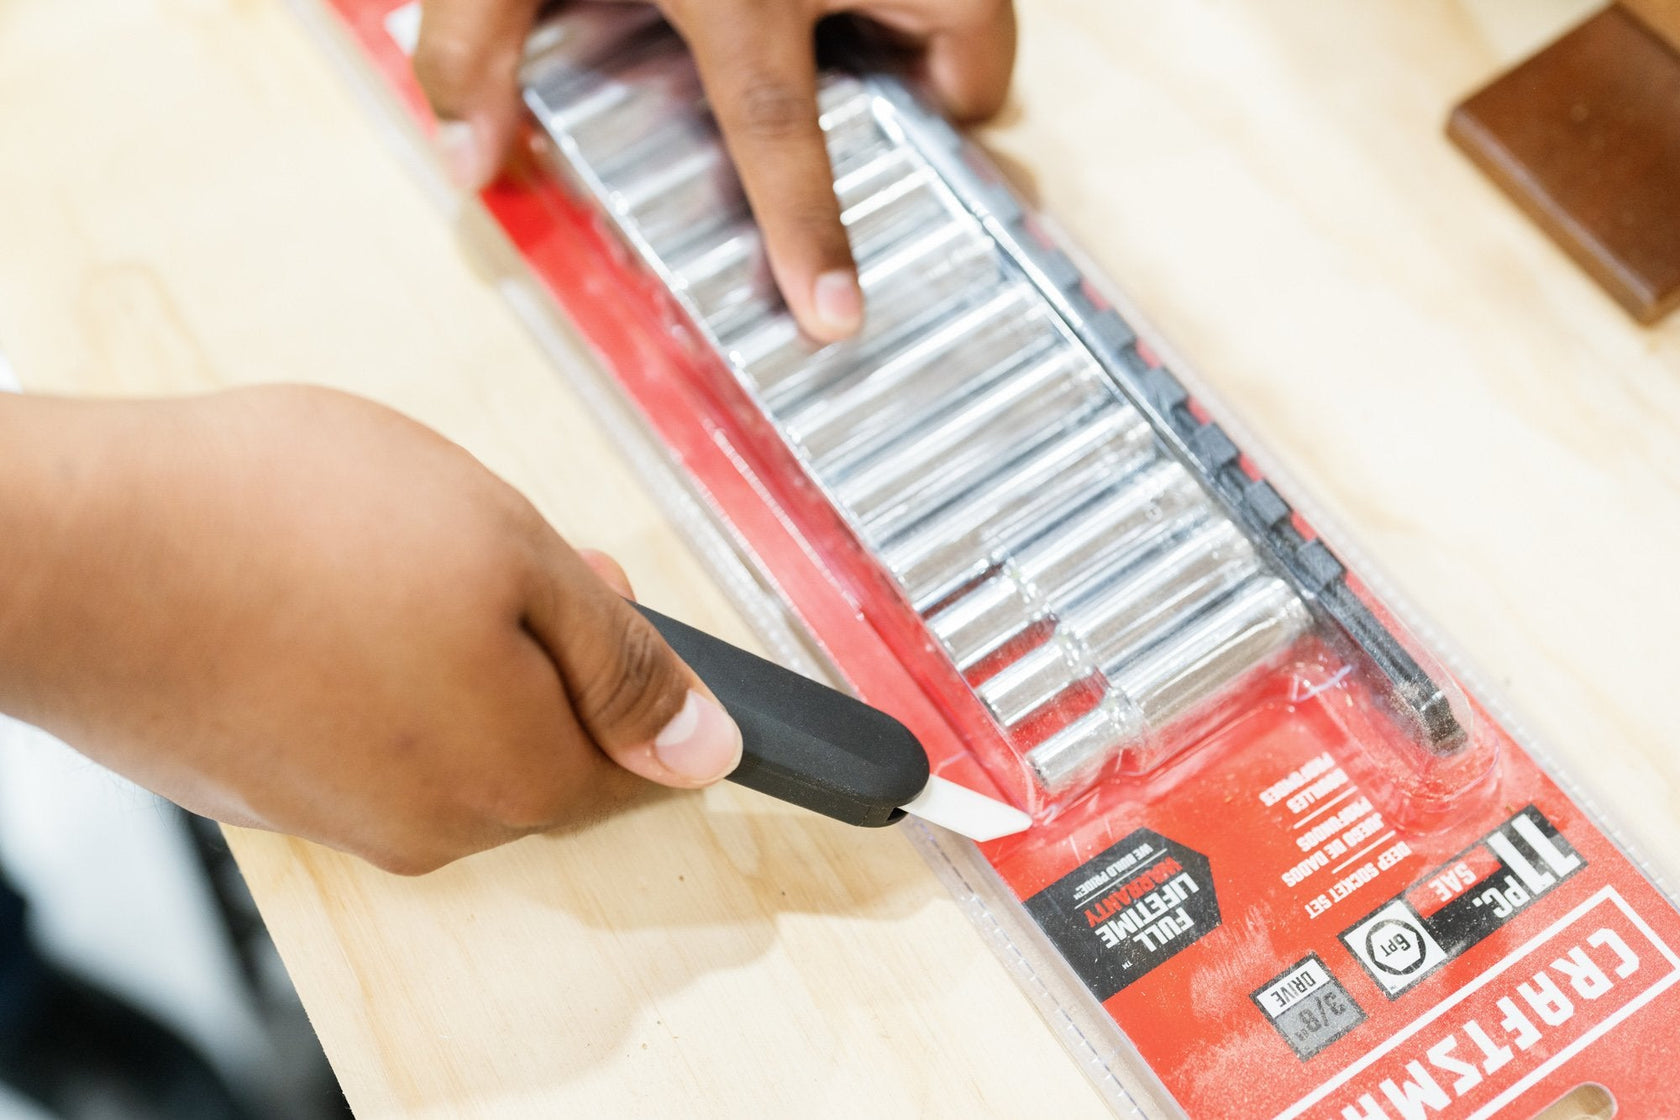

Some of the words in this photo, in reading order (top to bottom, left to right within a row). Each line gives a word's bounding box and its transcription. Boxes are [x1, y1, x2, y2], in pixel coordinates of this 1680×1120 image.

[1106, 853, 1137, 877] BUILD
[1132, 843, 1154, 861] WE
[1323, 838, 1348, 859] DE
[1377, 841, 1412, 871] DEEP
[1487, 813, 1581, 895] 11
[1281, 850, 1330, 887] DADOS
[1328, 862, 1379, 903] SOCKET
[1428, 861, 1477, 902] SAE
[1083, 856, 1183, 928] WARRANTY
[1094, 872, 1200, 949] LIFETIME
[1304, 894, 1332, 919] SET
[1472, 875, 1531, 918] PC.
[1132, 907, 1195, 953] FULL
[1380, 932, 1411, 957] 6PT
[1270, 970, 1316, 1007] DRIVE
